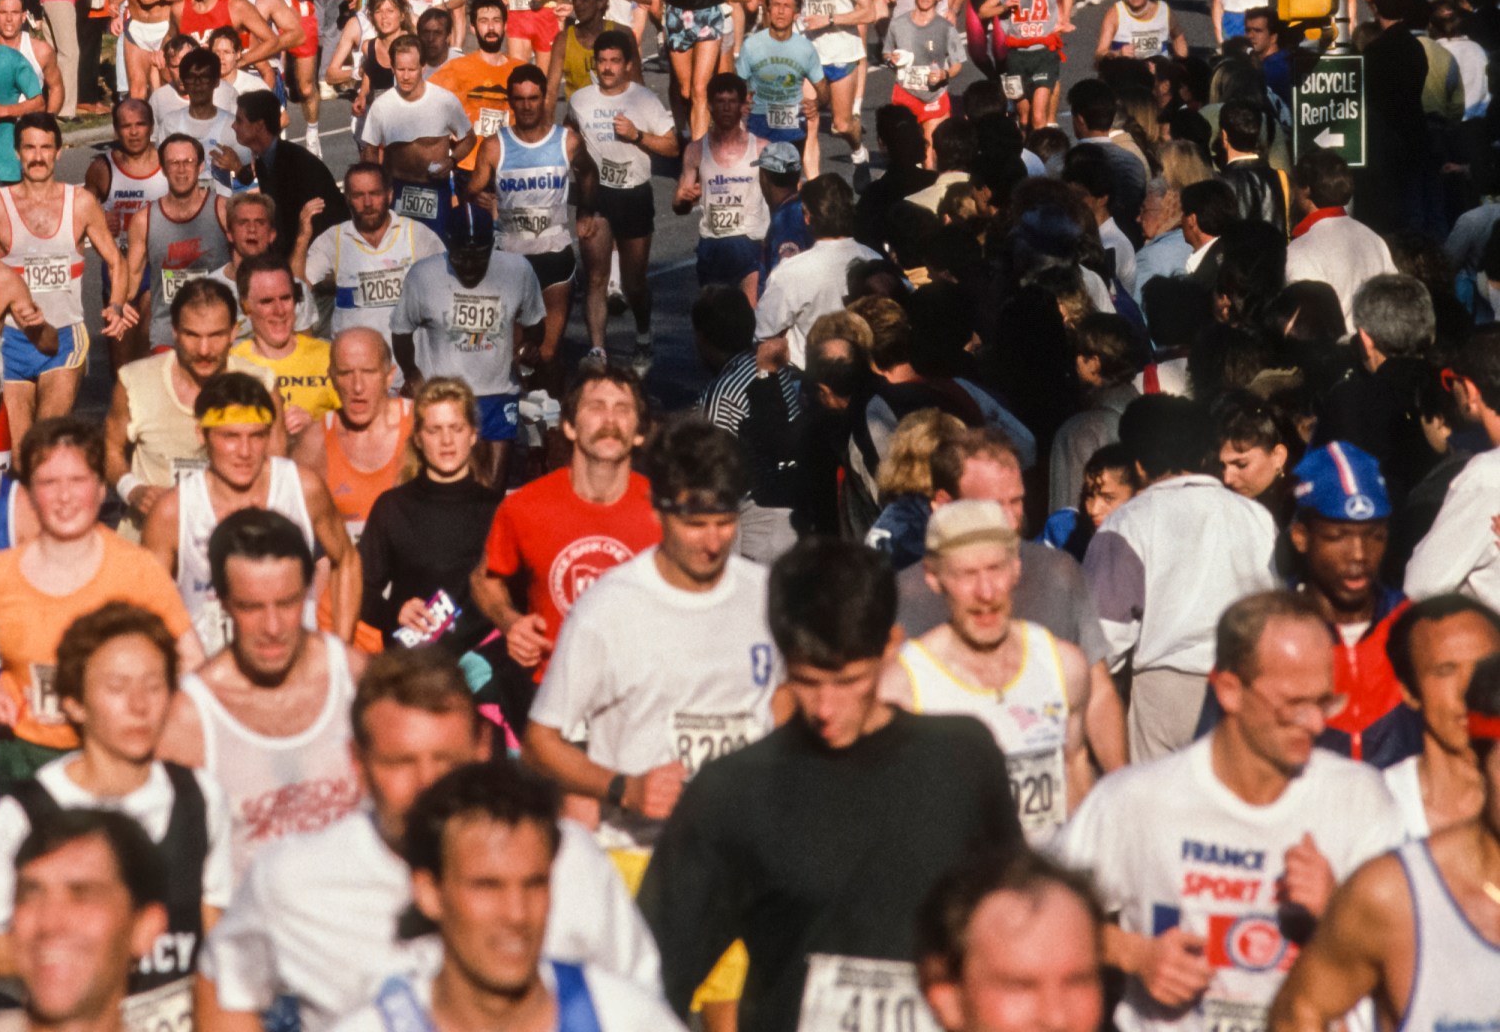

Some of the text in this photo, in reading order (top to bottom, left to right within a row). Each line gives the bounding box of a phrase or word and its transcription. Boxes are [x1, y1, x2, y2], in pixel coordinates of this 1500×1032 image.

[1301, 72, 1357, 95] BICYCLE
[768, 109, 795, 126] T826
[1301, 98, 1359, 126] Rentals
[596, 132, 615, 142] GIR
[600, 166, 629, 185] 9372
[707, 174, 754, 186] ellesse
[113, 189, 145, 199] FRANCE
[113, 199, 142, 210] SPORT
[401, 194, 435, 214] 15076
[24, 265, 67, 286] 19255
[360, 277, 401, 303] 12063
[276, 375, 329, 387] DNEY
[1181, 839, 1266, 871] FRANCE
[1182, 871, 1262, 904] SPORT
